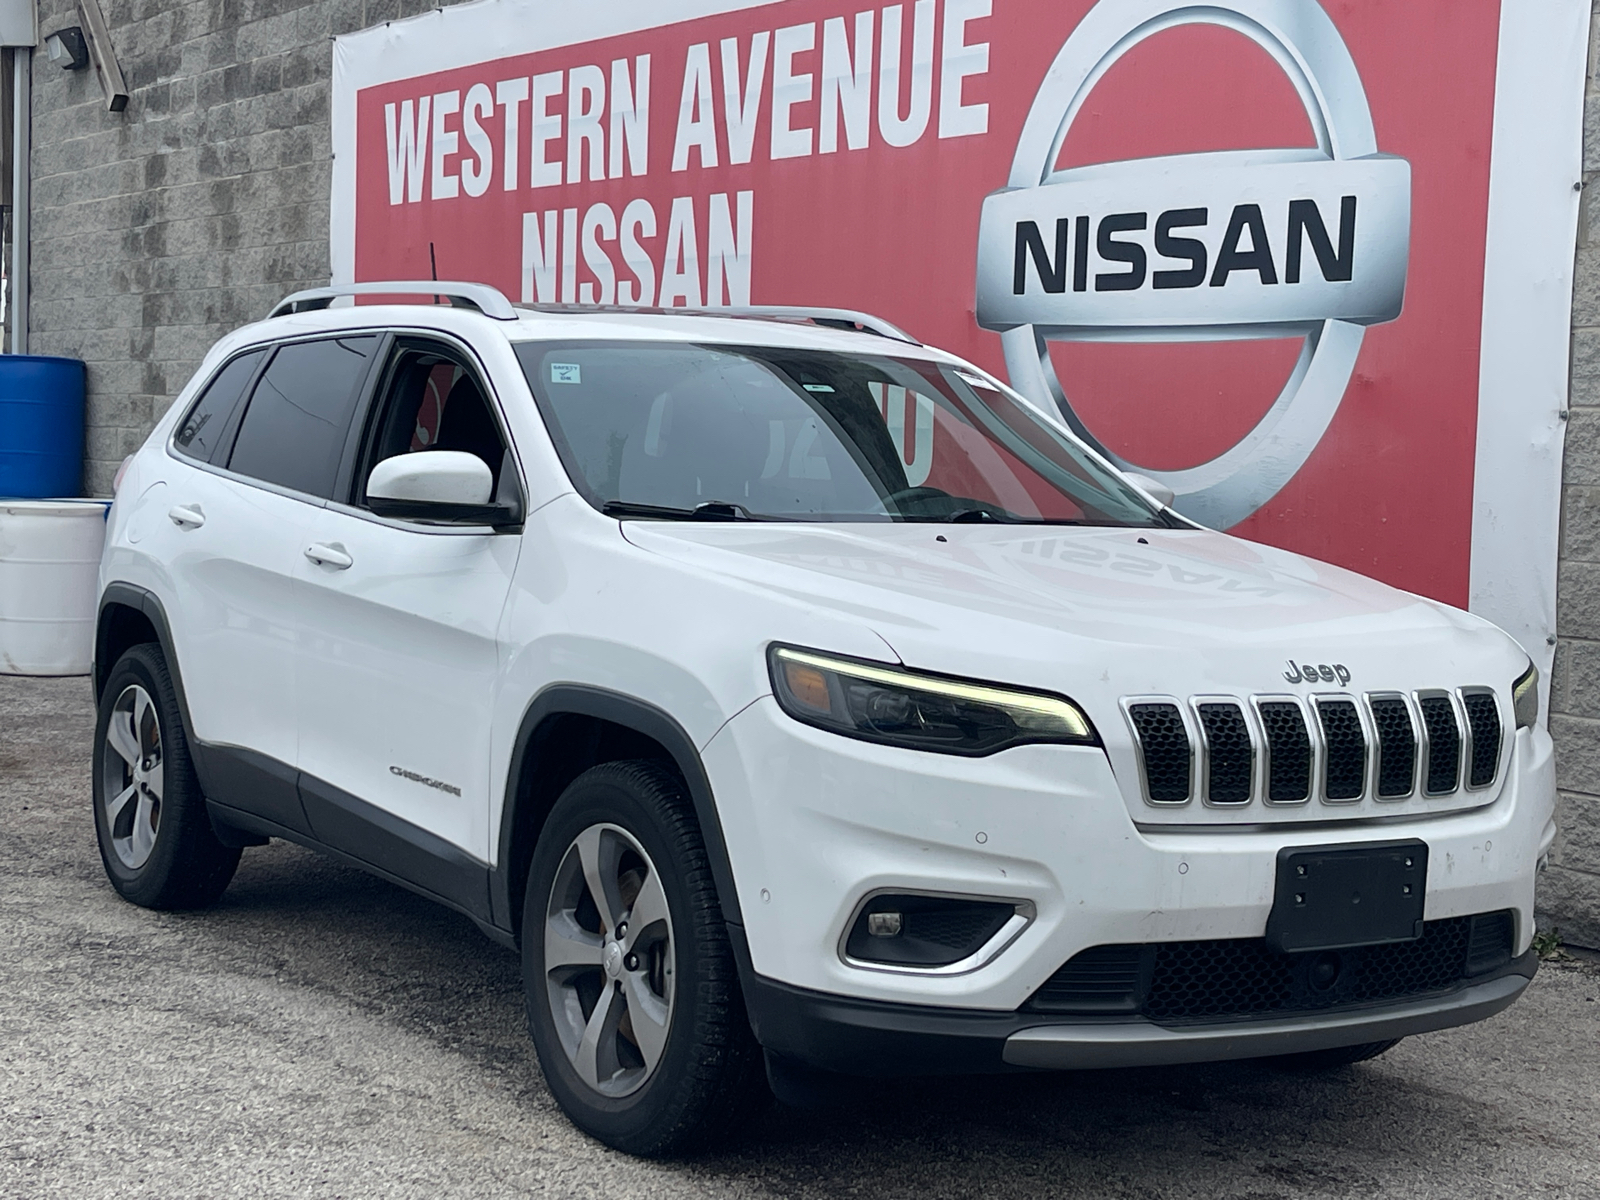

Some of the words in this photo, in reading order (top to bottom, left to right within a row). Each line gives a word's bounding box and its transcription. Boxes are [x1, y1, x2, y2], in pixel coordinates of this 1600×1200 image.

[385, 53, 651, 206] WESTERN
[672, 0, 991, 172] AVENUE
[521, 190, 754, 306] NISSAN
[1013, 195, 1357, 295] NISSAN
[1281, 659, 1351, 687] Jeep
